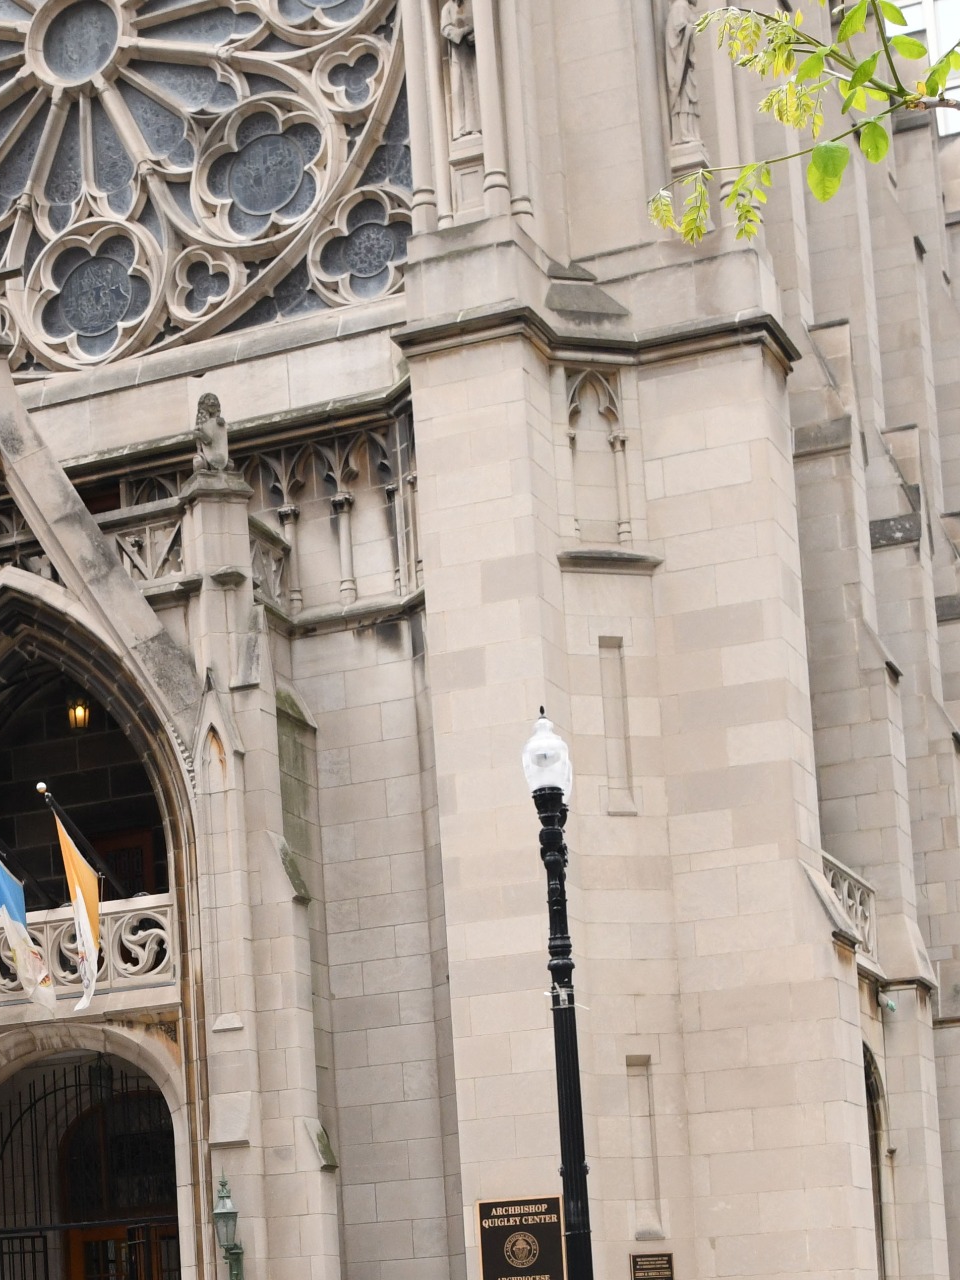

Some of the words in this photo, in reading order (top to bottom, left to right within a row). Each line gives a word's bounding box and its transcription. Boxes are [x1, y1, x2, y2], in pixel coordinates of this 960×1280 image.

[490, 1204, 548, 1216] ARCHBISHOP
[482, 1217, 520, 1228] QUIGLEY
[522, 1214, 558, 1224] CENTER
